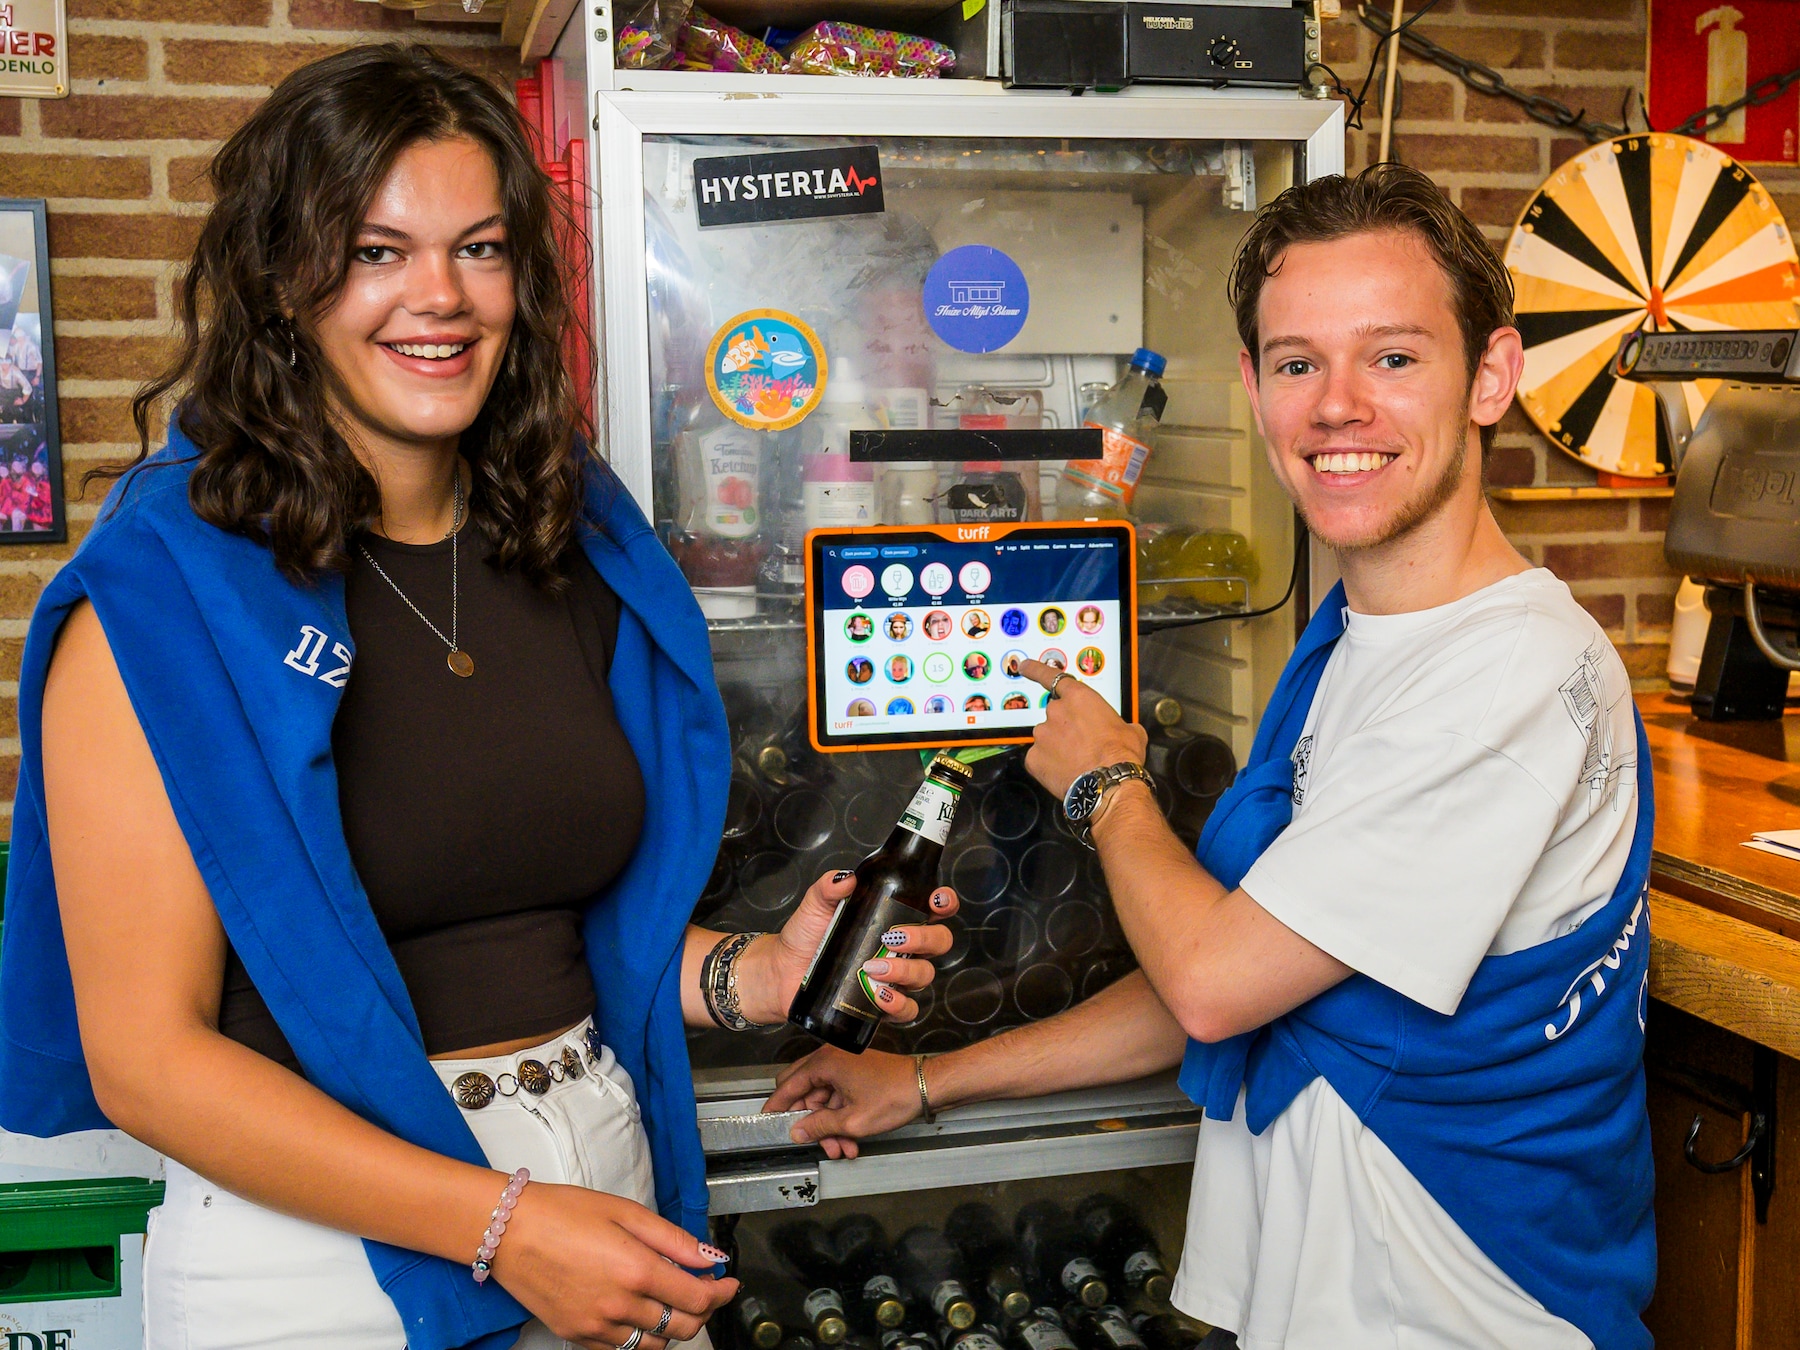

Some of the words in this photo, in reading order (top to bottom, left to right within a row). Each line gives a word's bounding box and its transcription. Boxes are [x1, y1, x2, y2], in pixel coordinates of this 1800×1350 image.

[0, 31, 56, 57] ER
[701, 168, 849, 204] HYSTERIA
[1530, 204, 1543, 218] 16
[728, 340, 756, 367] 35
[710, 458, 757, 476] Ketchup
[960, 508, 989, 518] DARK
[990, 507, 1018, 518] ARTS
[957, 526, 990, 540] turff
[283, 625, 353, 689] 12
[834, 720, 853, 729] turff
